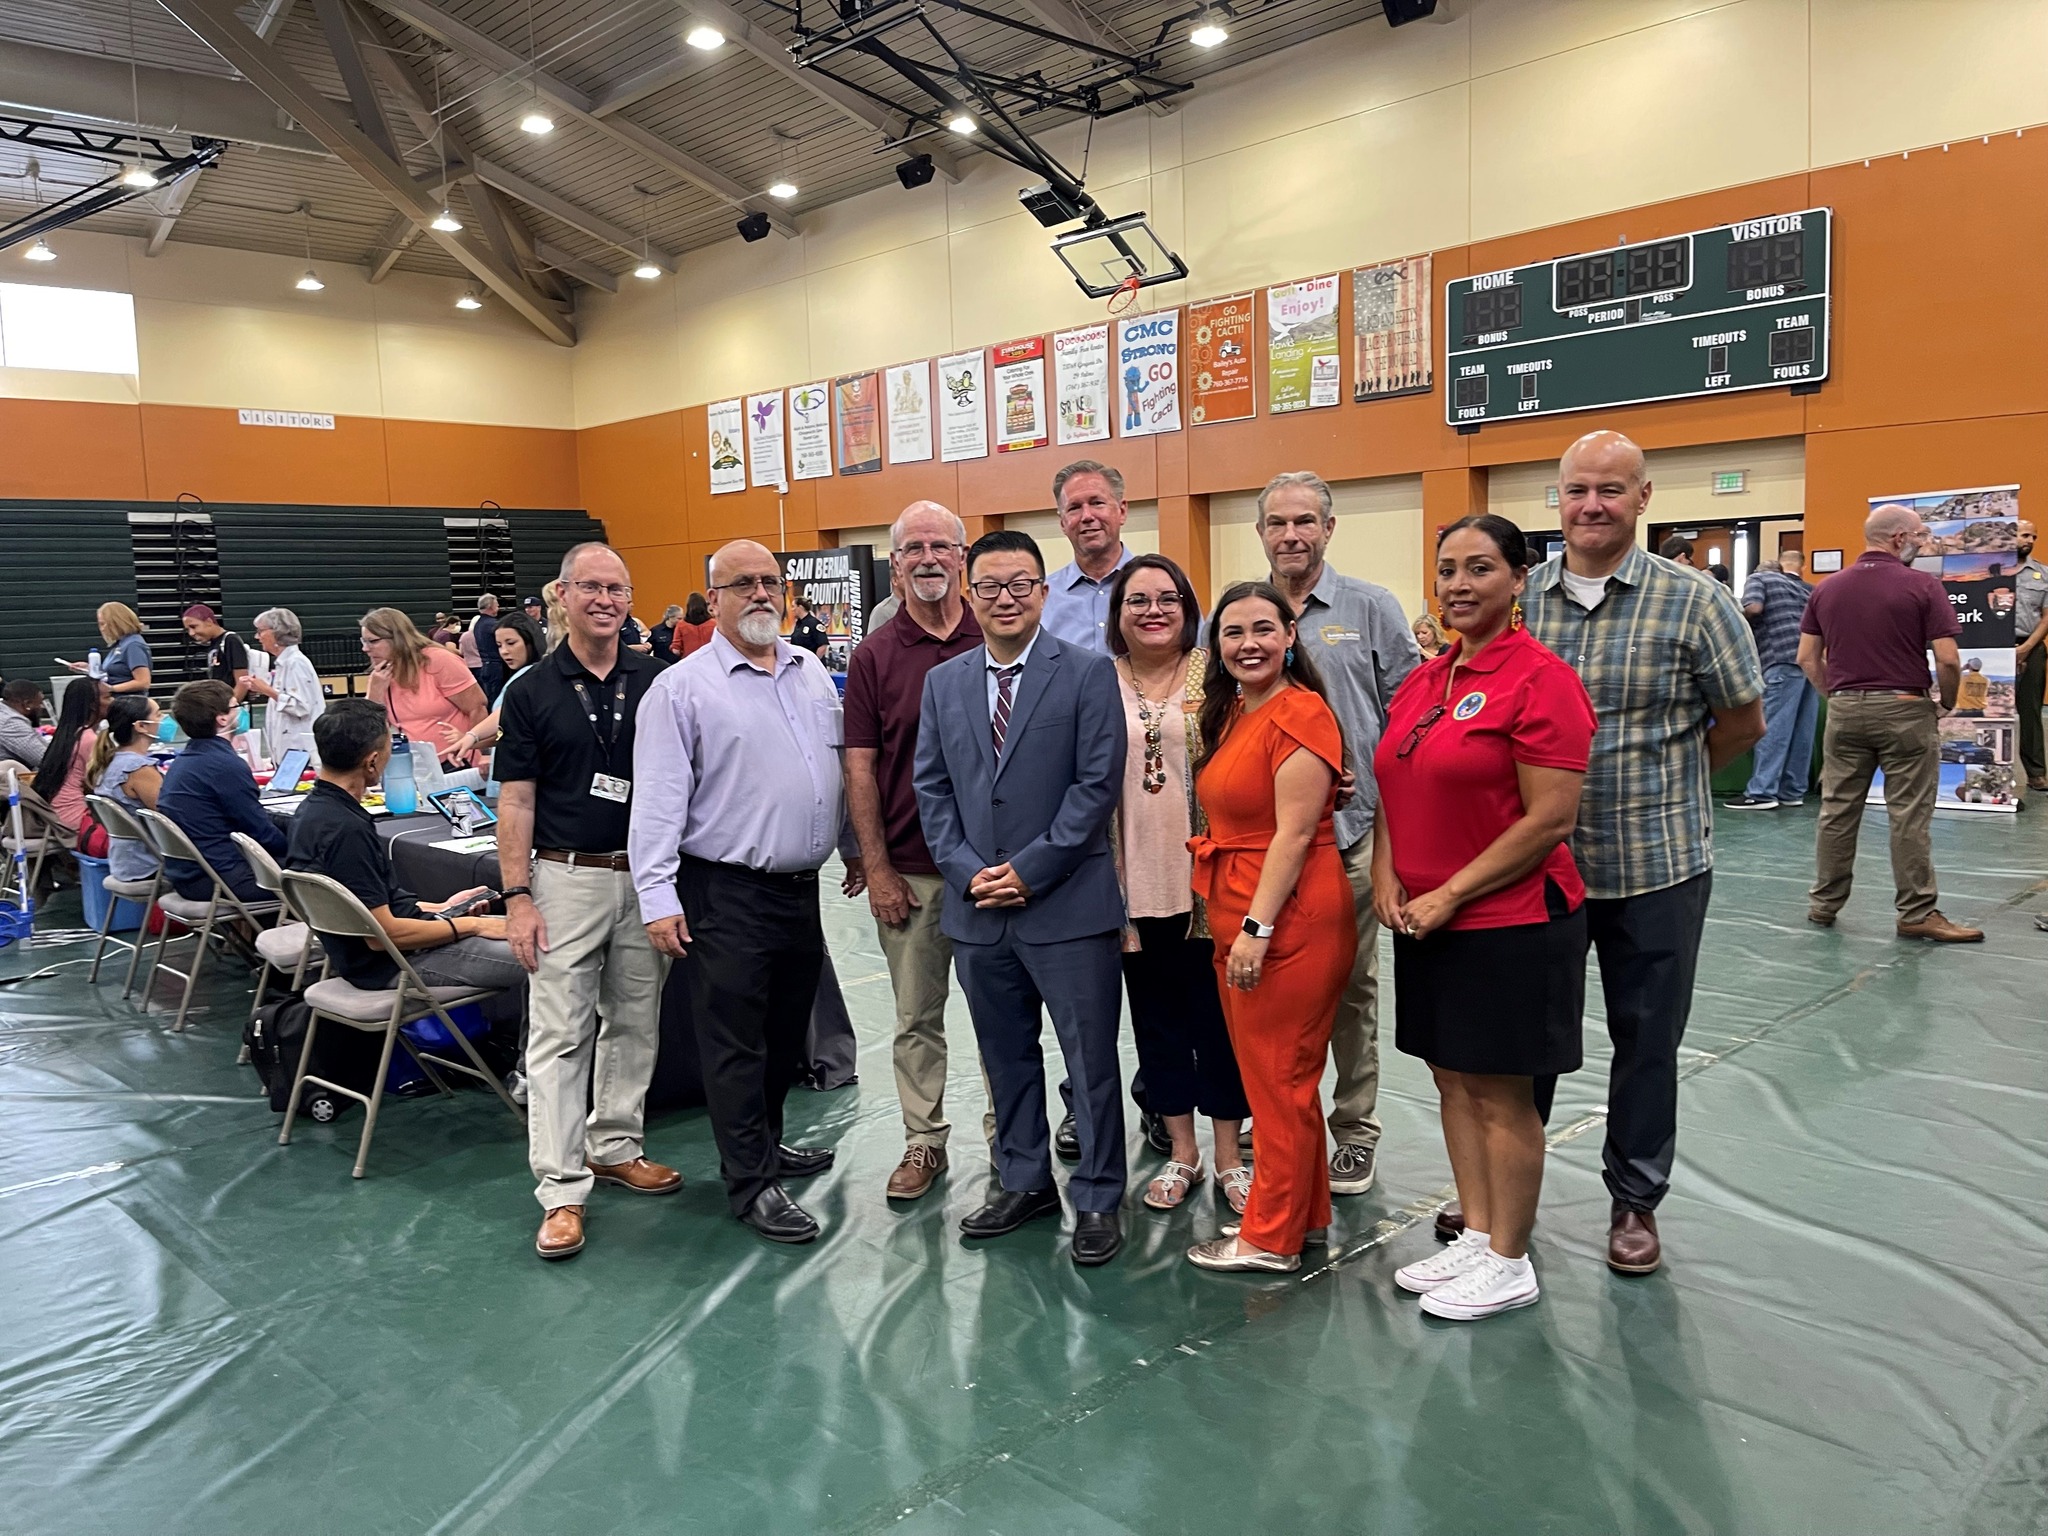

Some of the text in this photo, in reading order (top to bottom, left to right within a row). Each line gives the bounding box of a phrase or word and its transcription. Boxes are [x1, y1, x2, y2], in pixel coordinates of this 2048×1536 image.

[1731, 215, 1803, 242] VISITOR
[1306, 280, 1333, 292] Dine
[1472, 271, 1514, 292] HOME
[1652, 293, 1674, 304] POSS
[1746, 284, 1785, 301] BONUS
[1223, 305, 1237, 316] GO
[1281, 296, 1324, 316] Enjoy!
[1568, 308, 1588, 318] POSS
[1210, 313, 1251, 329] FIGHTING
[1588, 308, 1625, 324] PERIOD
[1776, 314, 1810, 330] TEAM
[1124, 320, 1173, 342] CMC
[1216, 324, 1245, 338] CACTI!
[1478, 331, 1508, 345] BONUS
[1692, 330, 1747, 348] TIMEOUTS
[1121, 343, 1177, 364] STRONG
[1148, 362, 1173, 382] GO
[1460, 364, 1485, 376] TEAM
[1506, 359, 1553, 375] TIMEOUTS
[1773, 364, 1811, 379] FOULS
[1705, 374, 1732, 388] LEFT
[1142, 382, 1177, 412] Fighting
[1151, 400, 1174, 424] Cacti
[1458, 407, 1486, 419] FOULS
[1518, 400, 1541, 412] LEFT
[241, 413, 332, 427] VISITORS
[785, 558, 814, 581] SAN
[804, 582, 842, 605] COUNTY
[1948, 593, 1968, 605] ee
[849, 570, 862, 650] WWW.SBCFI
[1957, 609, 1983, 622] ark
